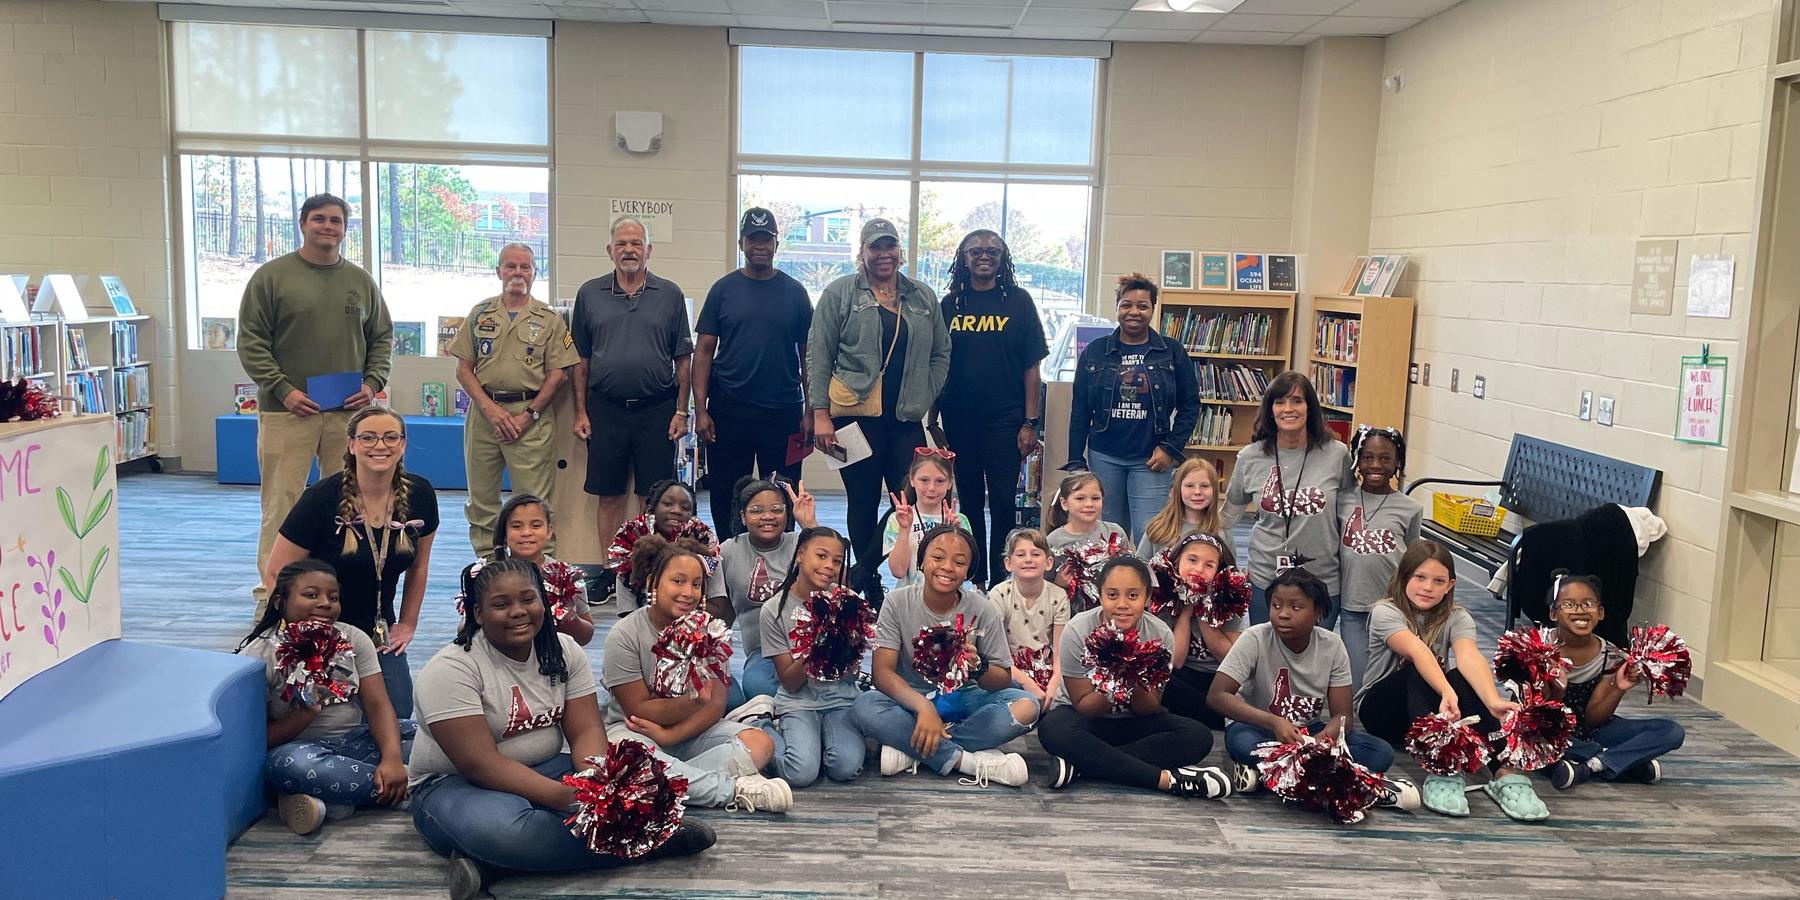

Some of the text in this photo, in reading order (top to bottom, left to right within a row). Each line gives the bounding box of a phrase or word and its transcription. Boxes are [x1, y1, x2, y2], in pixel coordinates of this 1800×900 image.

[611, 199, 674, 215] EVERYBODY
[948, 315, 1009, 333] ARMY
[1695, 384, 1704, 397] AT
[1131, 402, 1142, 410] THE
[1688, 397, 1712, 413] LUNCH
[1111, 408, 1148, 420] VETERAN
